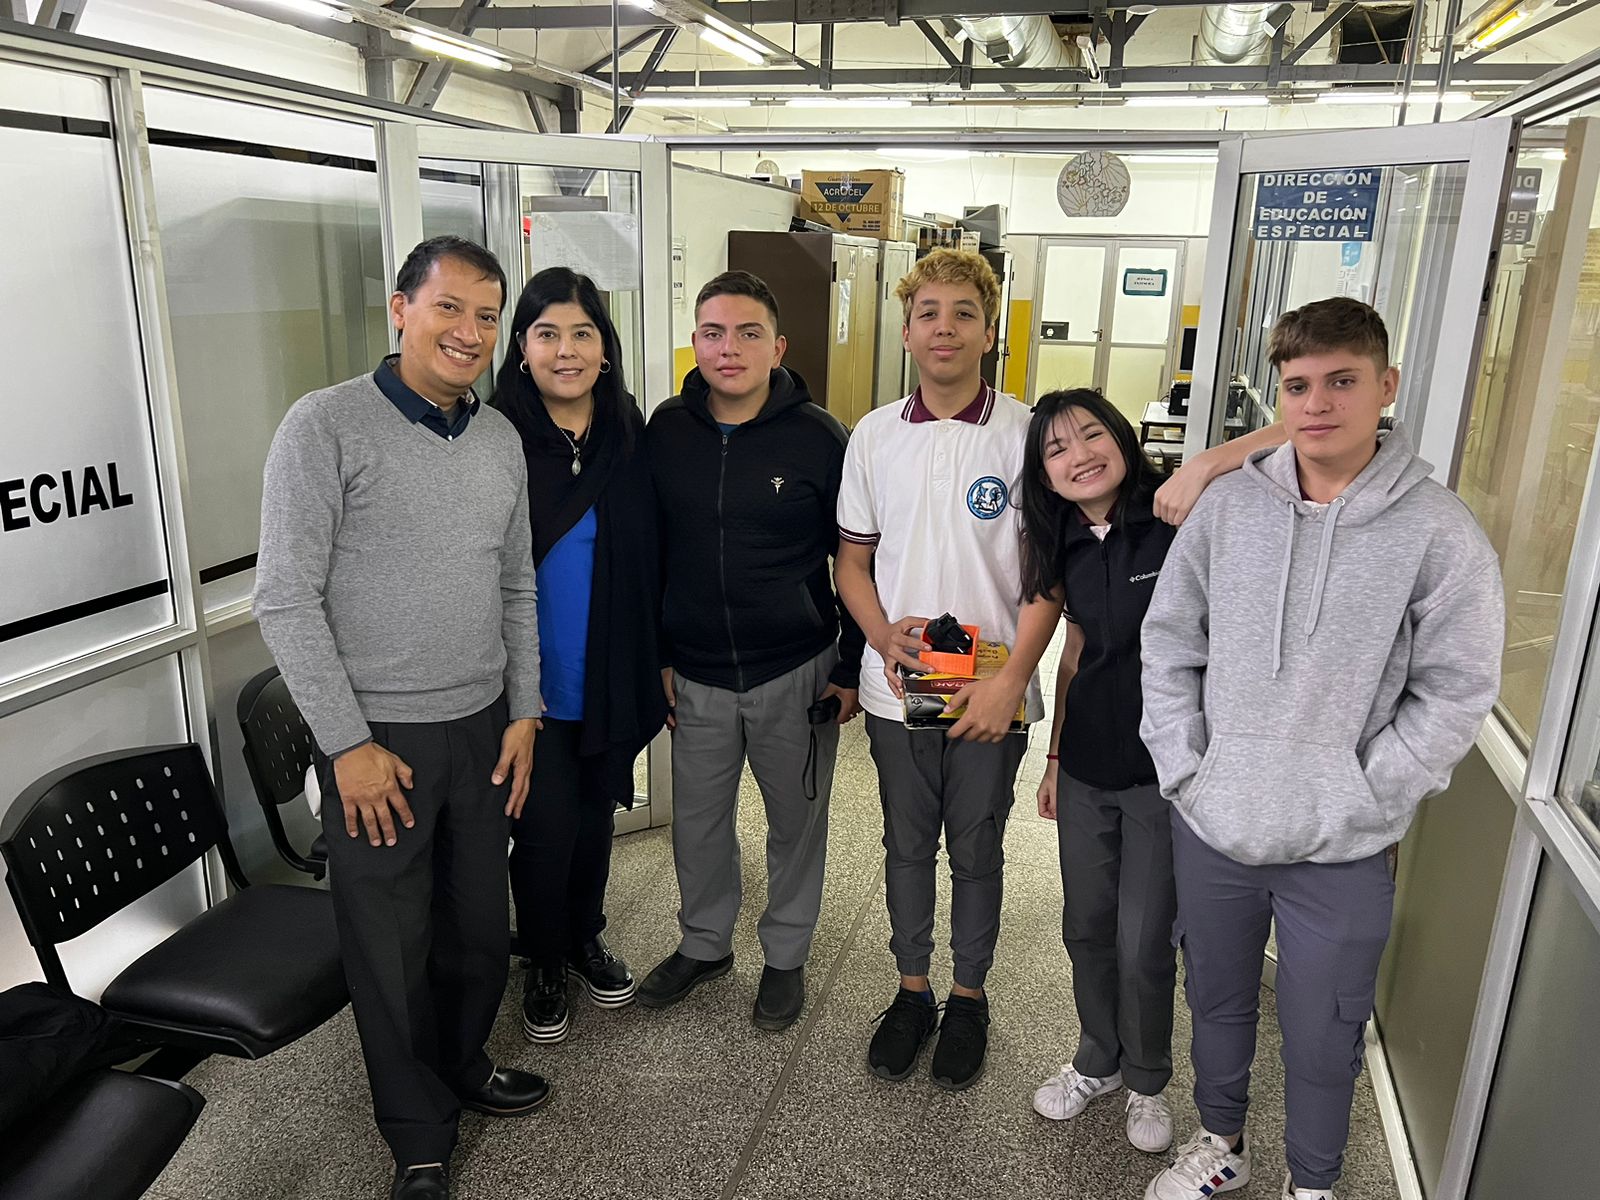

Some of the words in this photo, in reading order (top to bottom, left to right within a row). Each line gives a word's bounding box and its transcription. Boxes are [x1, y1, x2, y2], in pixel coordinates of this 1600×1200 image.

[1263, 170, 1372, 187] DIRECCIÓN
[823, 186, 864, 196] ACROCEL
[1303, 191, 1328, 204] DE
[814, 203, 824, 212] 12
[825, 203, 837, 212] DE
[838, 203, 880, 213] OCTUBRE
[1259, 204, 1368, 221] EDUCACIÓN
[1257, 225, 1366, 238] ESPECIAL
[0, 462, 134, 532] ECIAL
